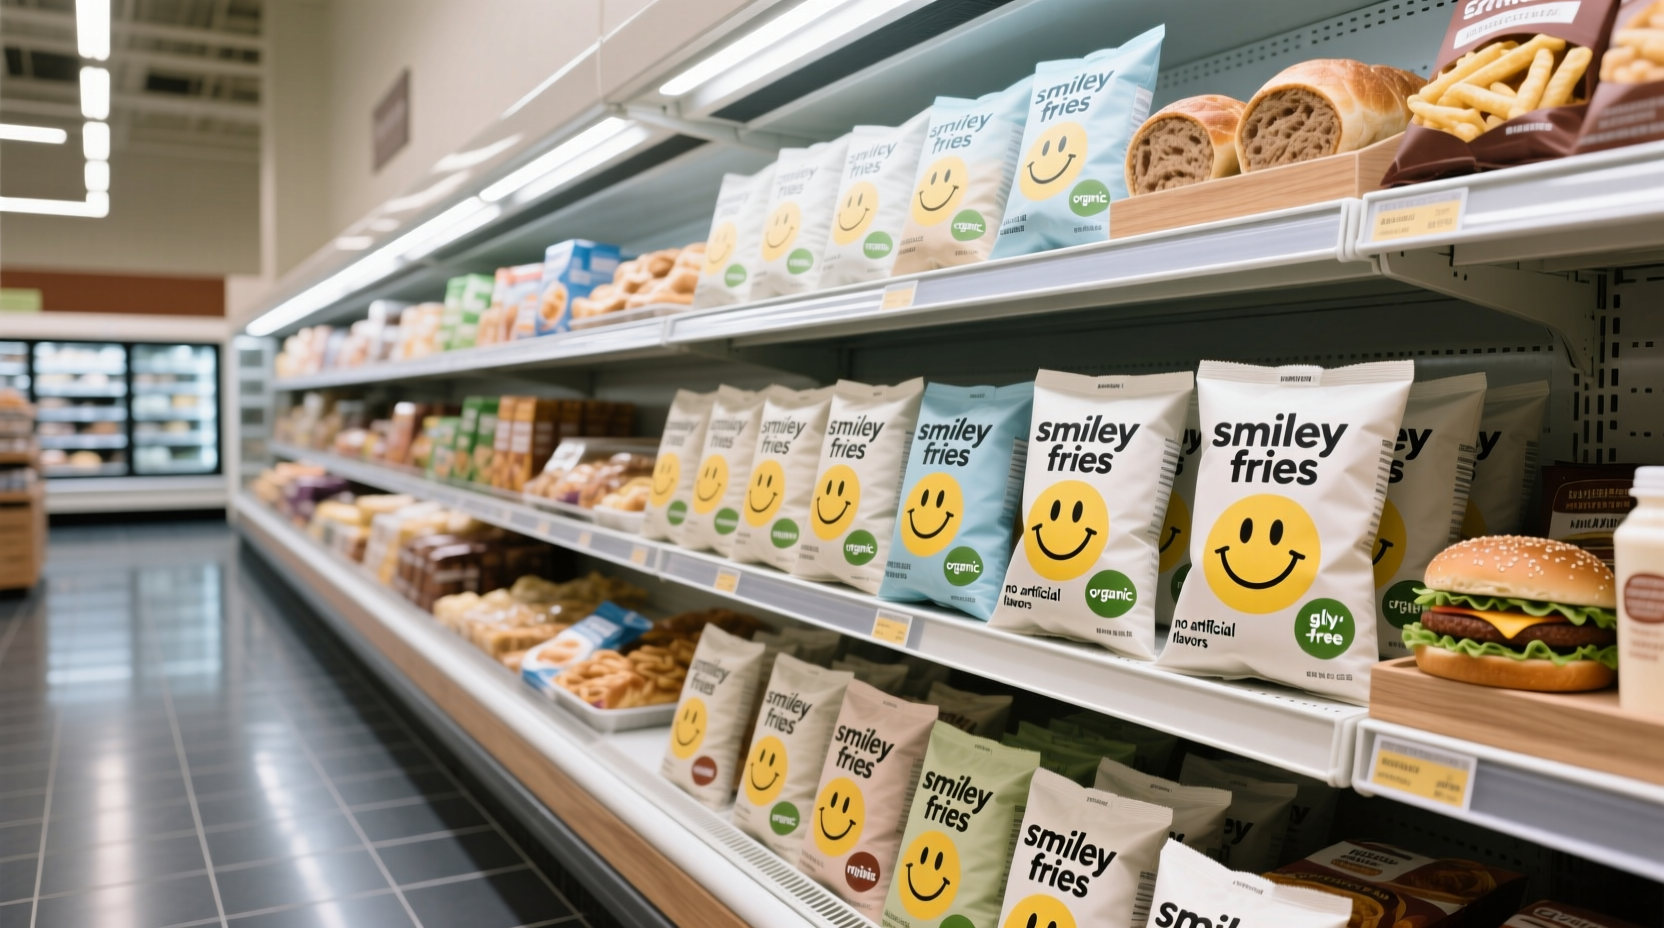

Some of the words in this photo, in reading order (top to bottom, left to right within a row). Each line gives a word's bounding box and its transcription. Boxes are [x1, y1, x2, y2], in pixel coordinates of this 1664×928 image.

[1035, 70, 1114, 104] smiley
[1040, 96, 1091, 123] fries
[929, 112, 994, 139] smiley
[932, 133, 972, 155] fries
[828, 415, 885, 443] smiley
[917, 417, 993, 448] smiley
[1035, 415, 1141, 453] smiley
[1212, 413, 1349, 458] smiley
[829, 438, 867, 459] fries
[922, 442, 970, 467] fries
[1046, 444, 1115, 475] fries
[1230, 449, 1319, 486] fries
[1005, 584, 1018, 594] no
[1089, 587, 1133, 603] organic
[1174, 619, 1188, 630] no
[764, 707, 796, 735] fries
[765, 690, 813, 721] smiley
[835, 725, 895, 763] smiley
[835, 746, 875, 779] fries
[922, 771, 994, 815] smiley
[924, 795, 971, 832] fries
[1024, 824, 1118, 878] smiley
[1028, 852, 1090, 898] fries
